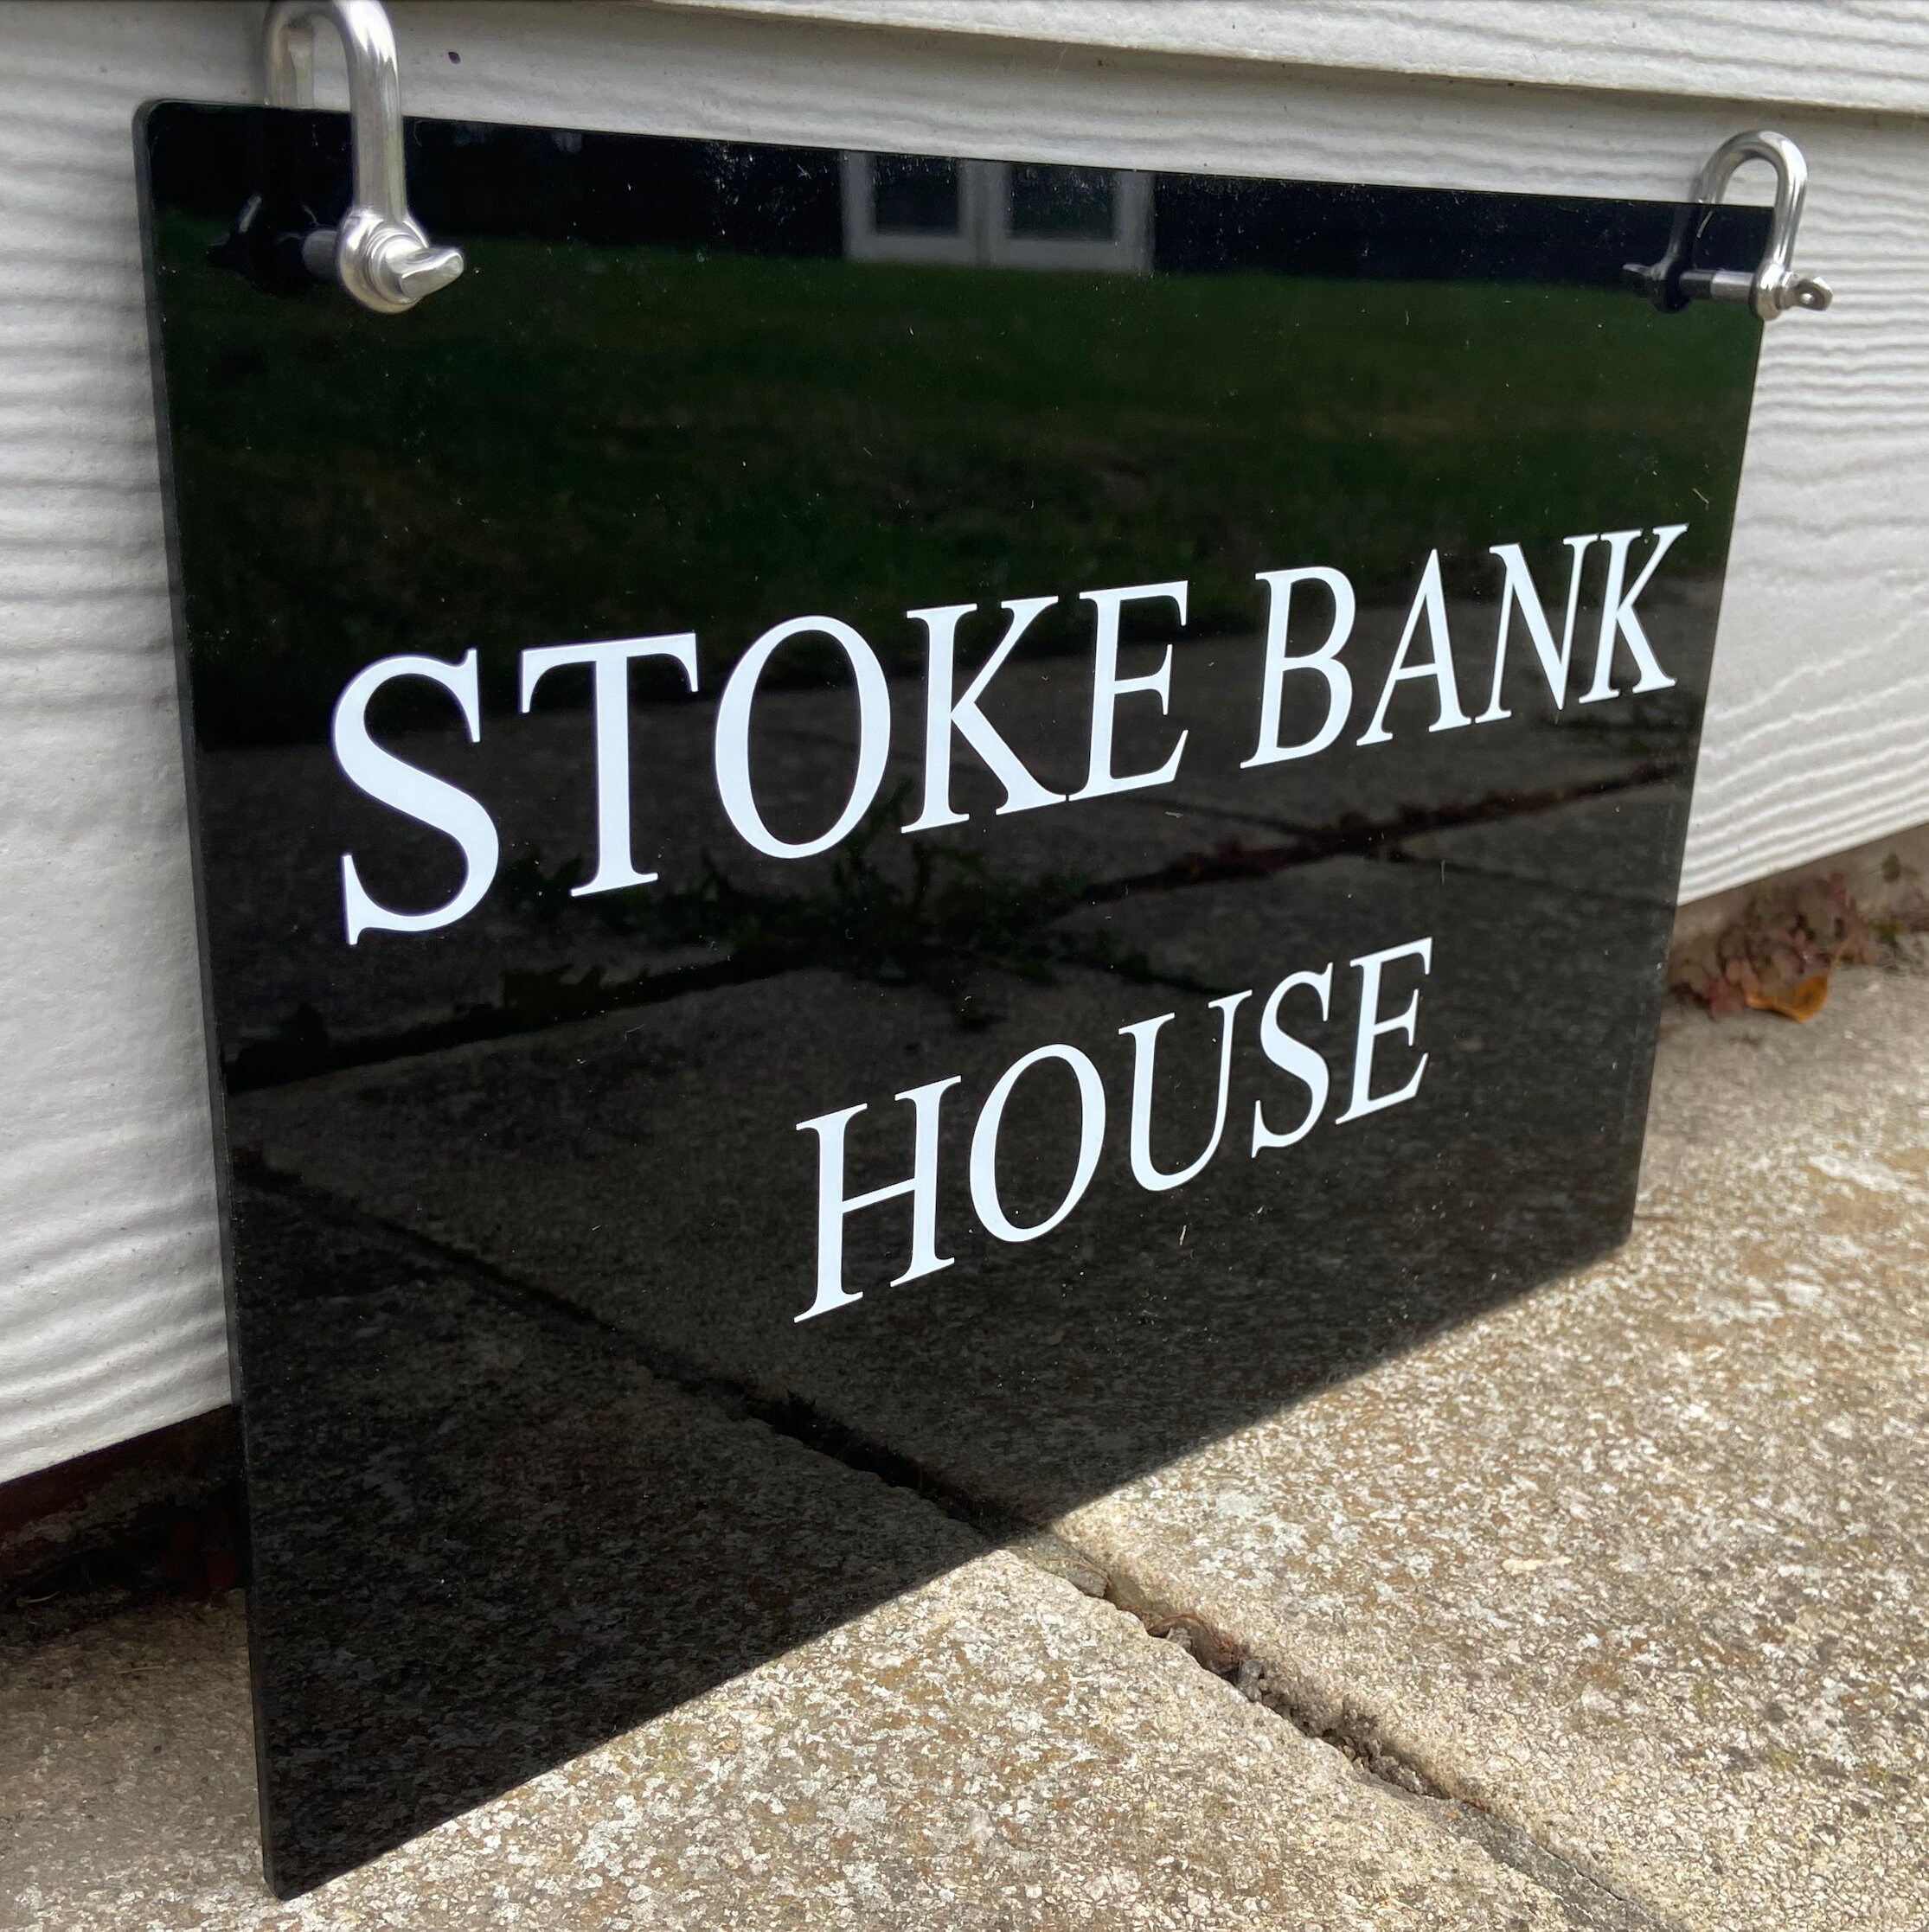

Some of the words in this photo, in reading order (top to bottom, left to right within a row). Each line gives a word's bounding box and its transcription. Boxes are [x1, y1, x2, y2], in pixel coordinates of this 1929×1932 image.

[332, 579, 1189, 946] STOKE
[1239, 523, 1689, 769] BANK
[793, 937, 1433, 1324] HOUSE
